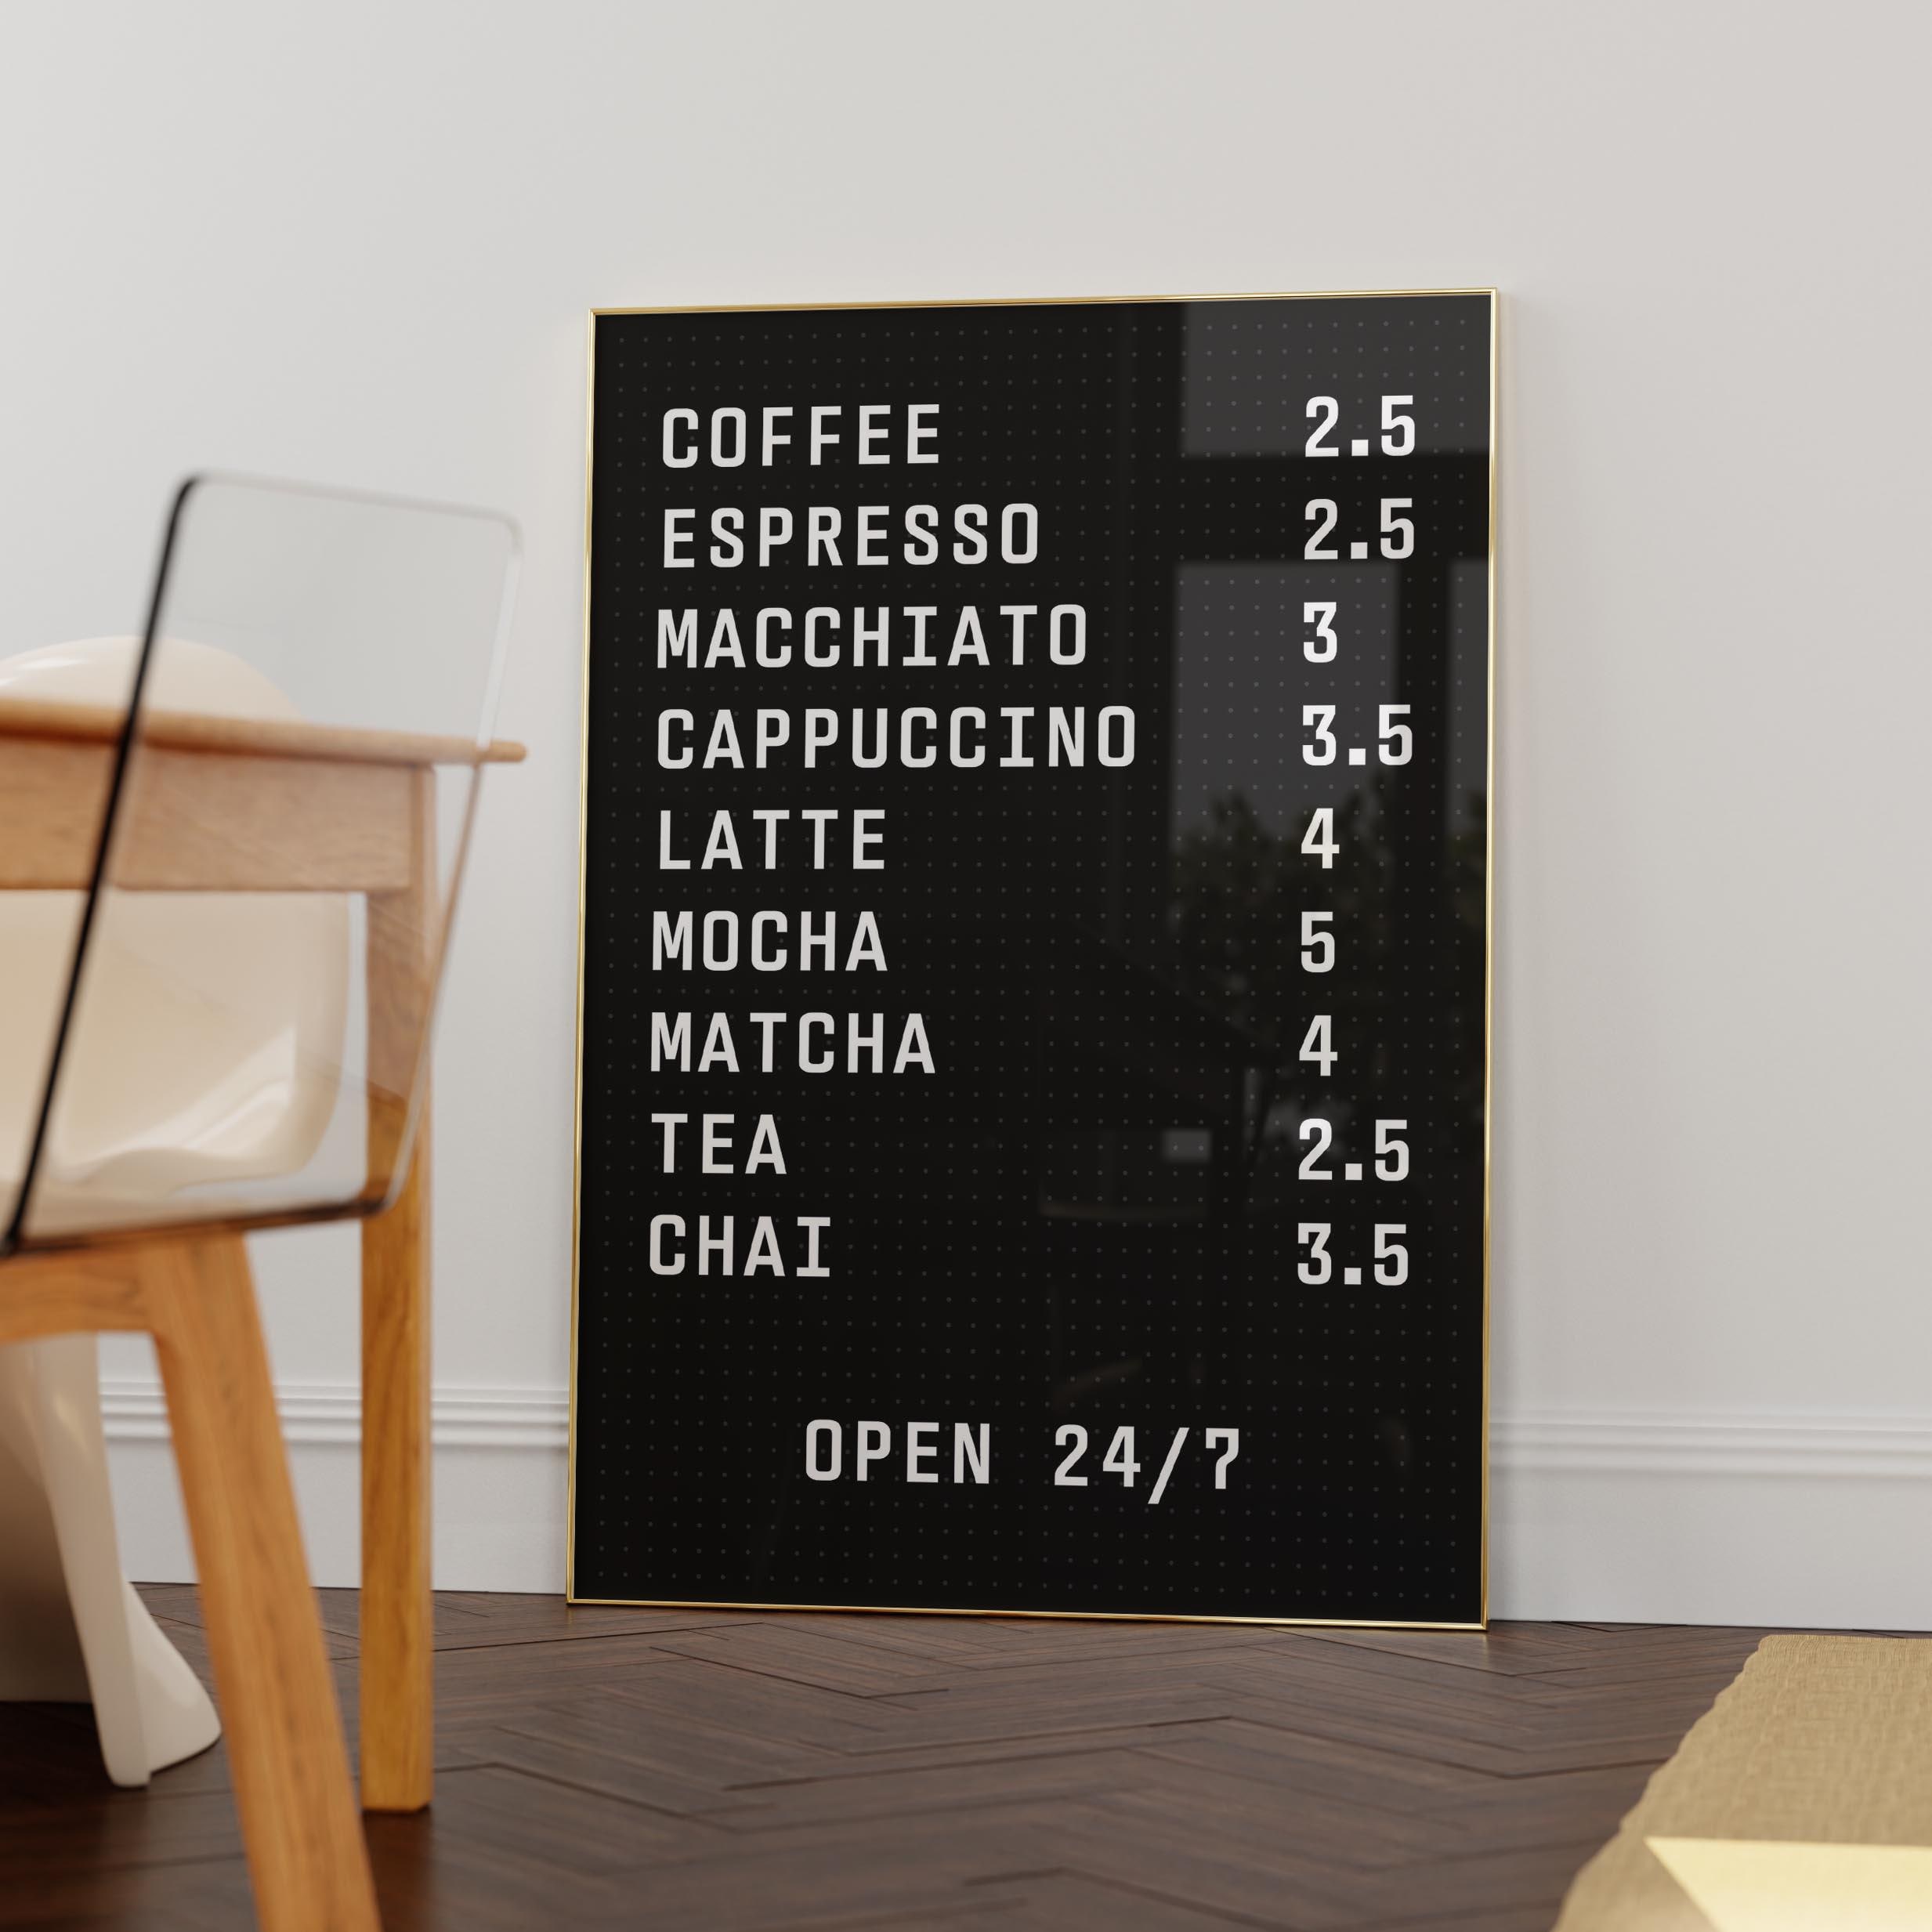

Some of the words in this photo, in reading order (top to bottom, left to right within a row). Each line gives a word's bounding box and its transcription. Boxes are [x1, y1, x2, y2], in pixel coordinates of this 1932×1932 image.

[662, 403, 939, 469] COFFEE
[1304, 394, 1416, 458] 2.5
[664, 503, 1038, 568] ESPRESSO
[1304, 497, 1415, 560] 2.5
[657, 604, 1087, 668] MACCHIATO
[1303, 601, 1337, 664] 3
[657, 705, 1135, 769] CAPPUCCINO
[1302, 704, 1413, 766] 3.5
[660, 809, 885, 870] LATTE
[1301, 808, 1340, 869] 4
[653, 910, 888, 971] MOCHA
[1301, 911, 1335, 973] 5
[650, 1011, 935, 1074] MATCHA
[1299, 1015, 1338, 1076] 4
[651, 1113, 787, 1174] TEA
[1298, 1118, 1409, 1181] 2.5
[649, 1214, 830, 1277] CHAI
[1297, 1222, 1409, 1286] 3.5
[805, 1419, 990, 1484] OPEN
[1055, 1424, 1239, 1504] 24/7
